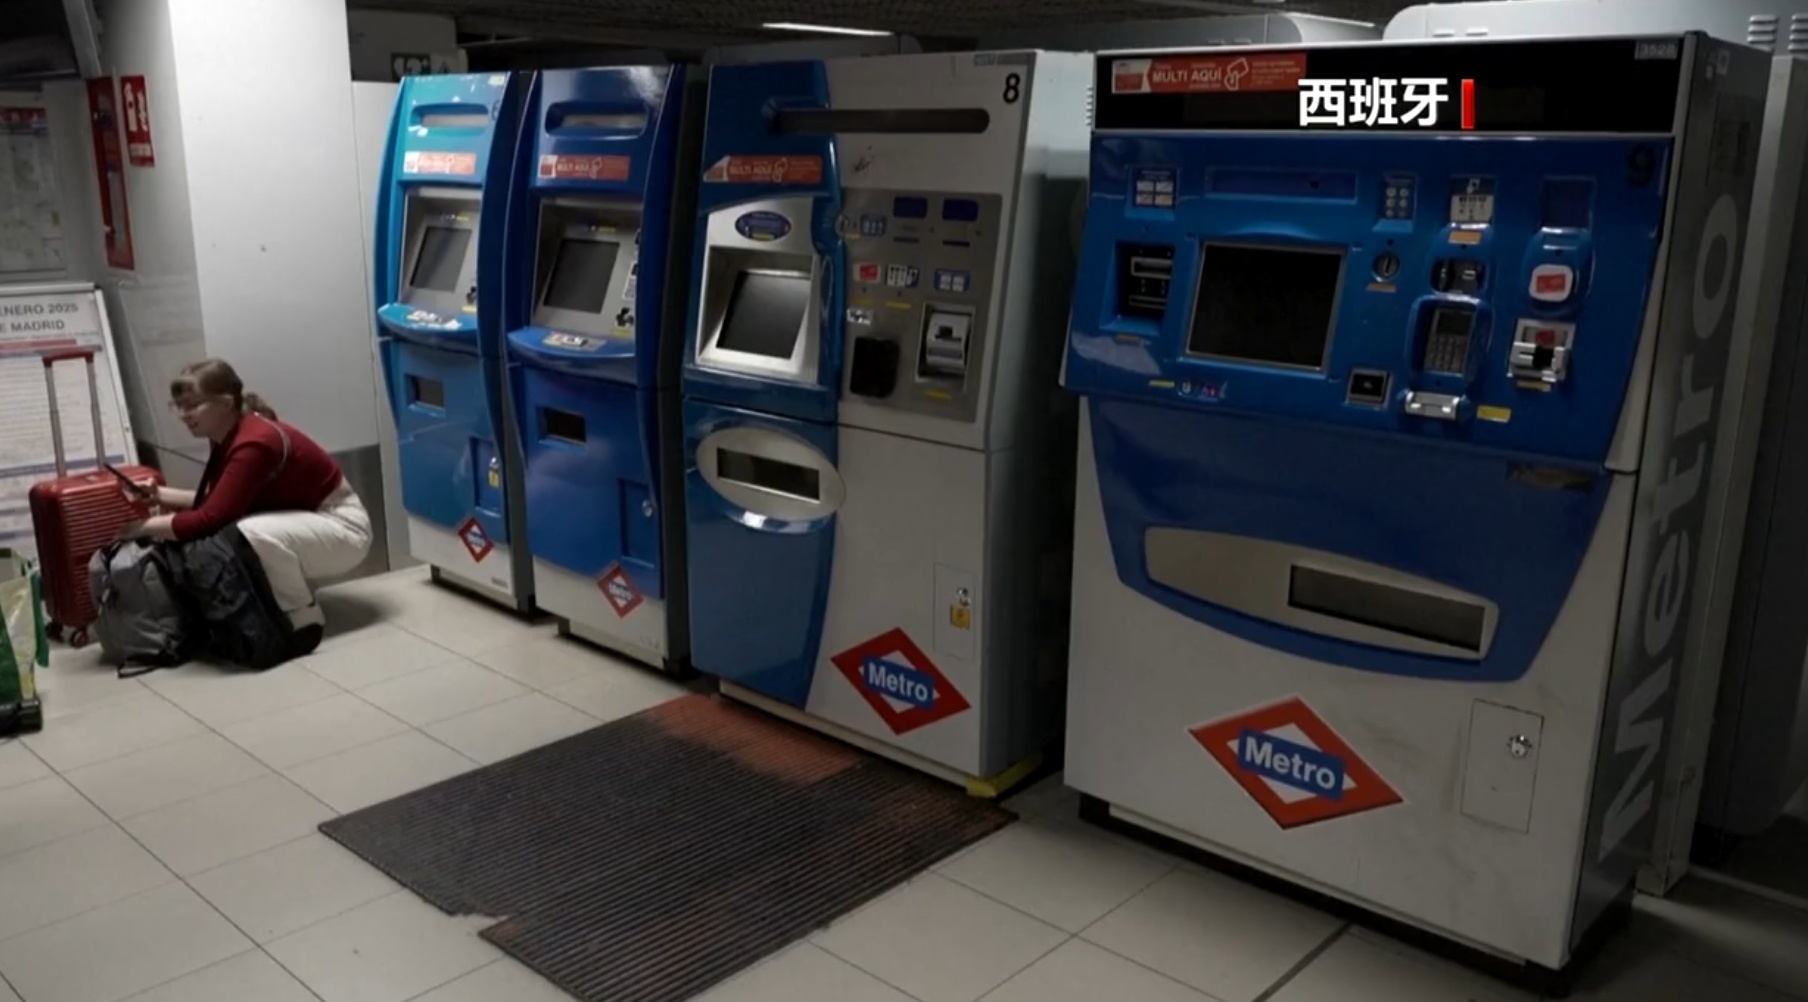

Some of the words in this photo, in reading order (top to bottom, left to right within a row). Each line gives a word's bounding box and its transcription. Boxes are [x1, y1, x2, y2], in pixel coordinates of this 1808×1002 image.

[1003, 72, 1021, 105] 8
[1152, 70, 1188, 83] MULTI
[1190, 67, 1223, 82] AQUÍ
[1627, 143, 1656, 187] 9
[11, 319, 65, 332] MADRID
[47, 302, 78, 314] 2025
[1598, 194, 1739, 863] Metro
[868, 661, 928, 701] Metro
[1245, 736, 1326, 790] Metro
